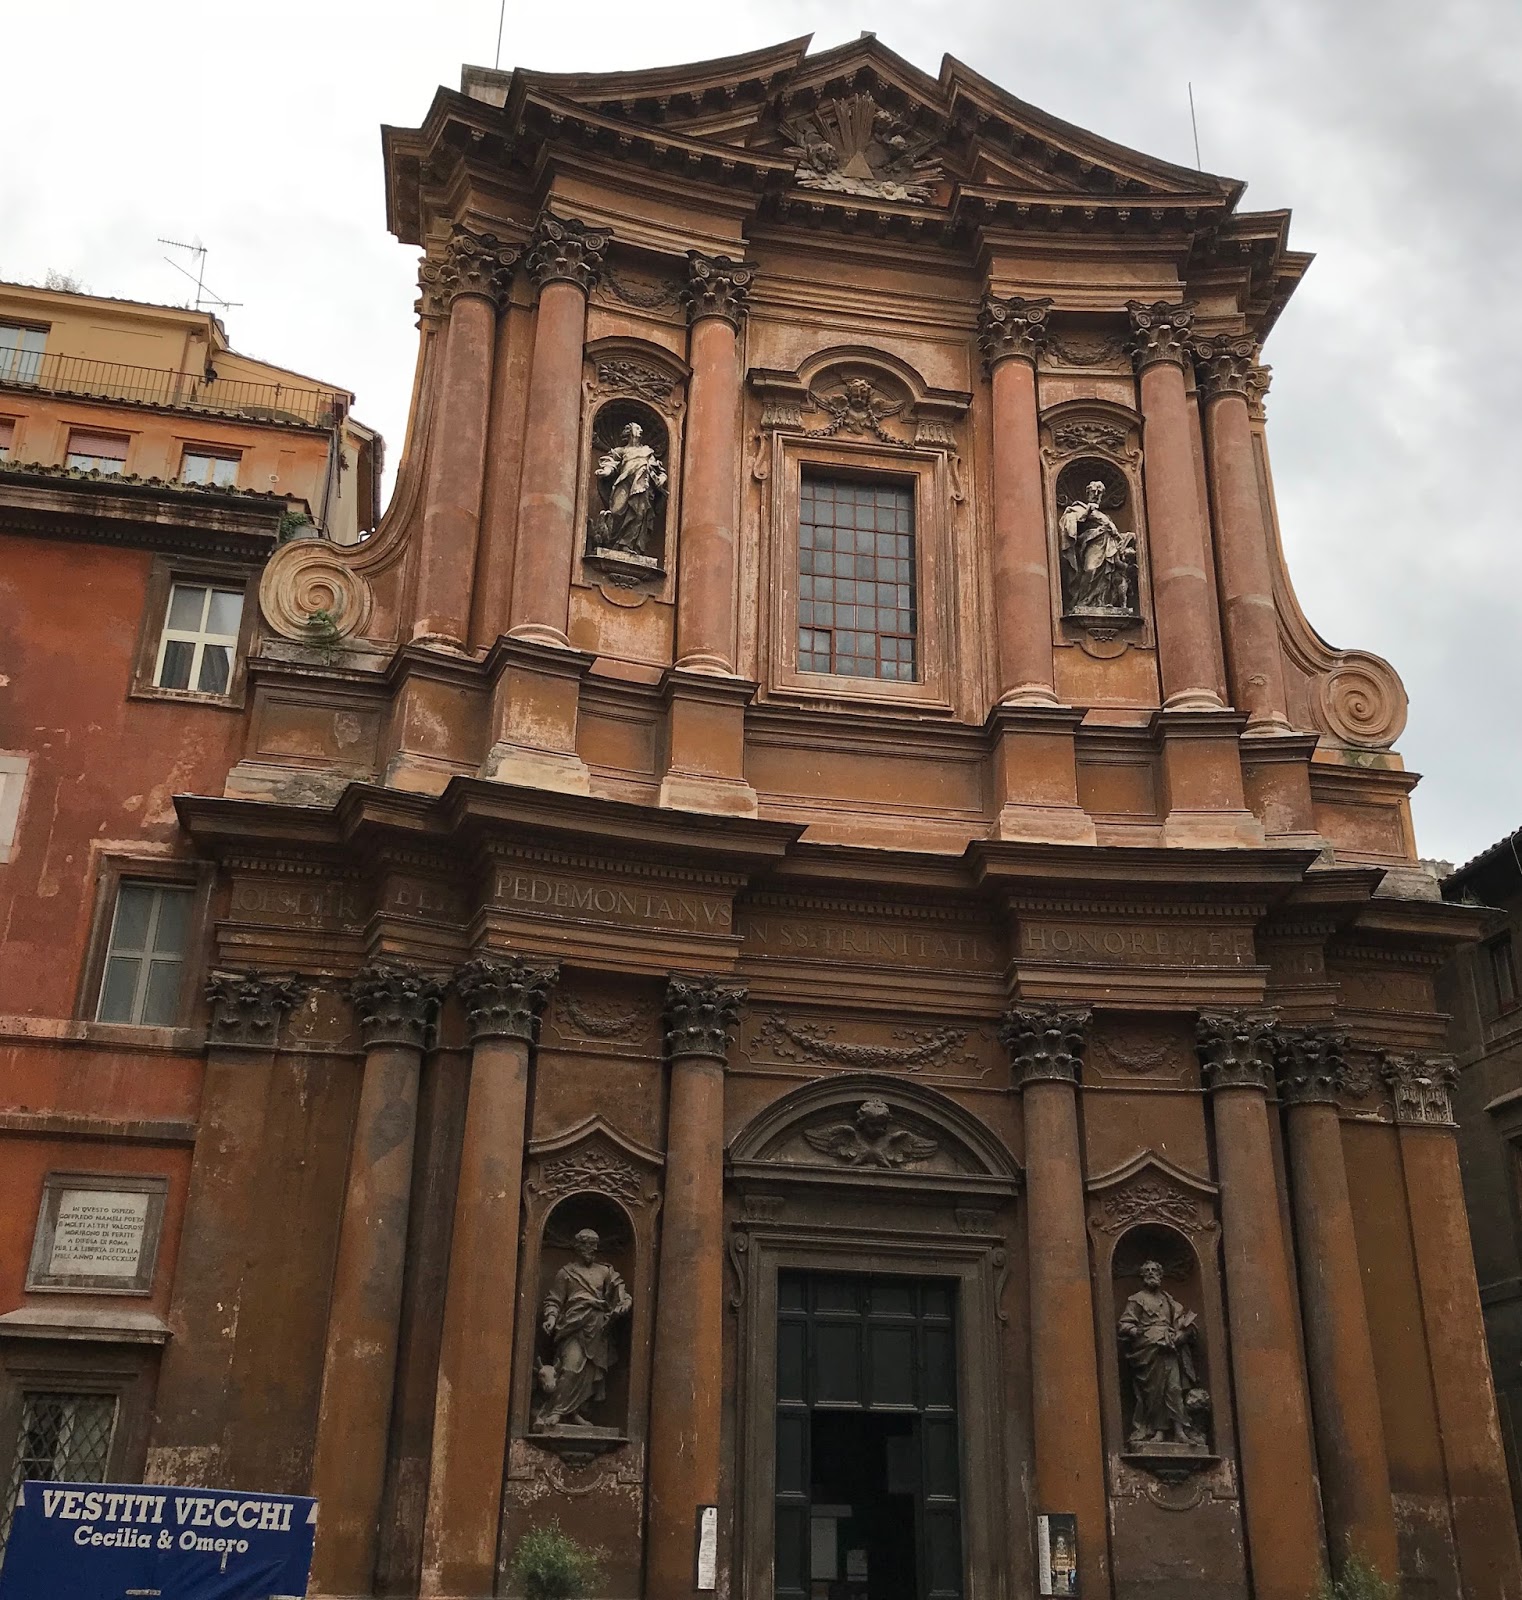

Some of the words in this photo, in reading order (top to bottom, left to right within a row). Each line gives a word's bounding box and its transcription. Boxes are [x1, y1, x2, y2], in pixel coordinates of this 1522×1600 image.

[494, 873, 732, 926] PEDEMONTANVS
[818, 926, 997, 963] TRINITATIS
[1025, 927, 1200, 956] HONOREM
[42, 1489, 167, 1524] VESTITI
[174, 1497, 294, 1532] VECCHI
[73, 1525, 153, 1549] Cecilia
[156, 1529, 173, 1550] &
[178, 1531, 249, 1554] Omero
